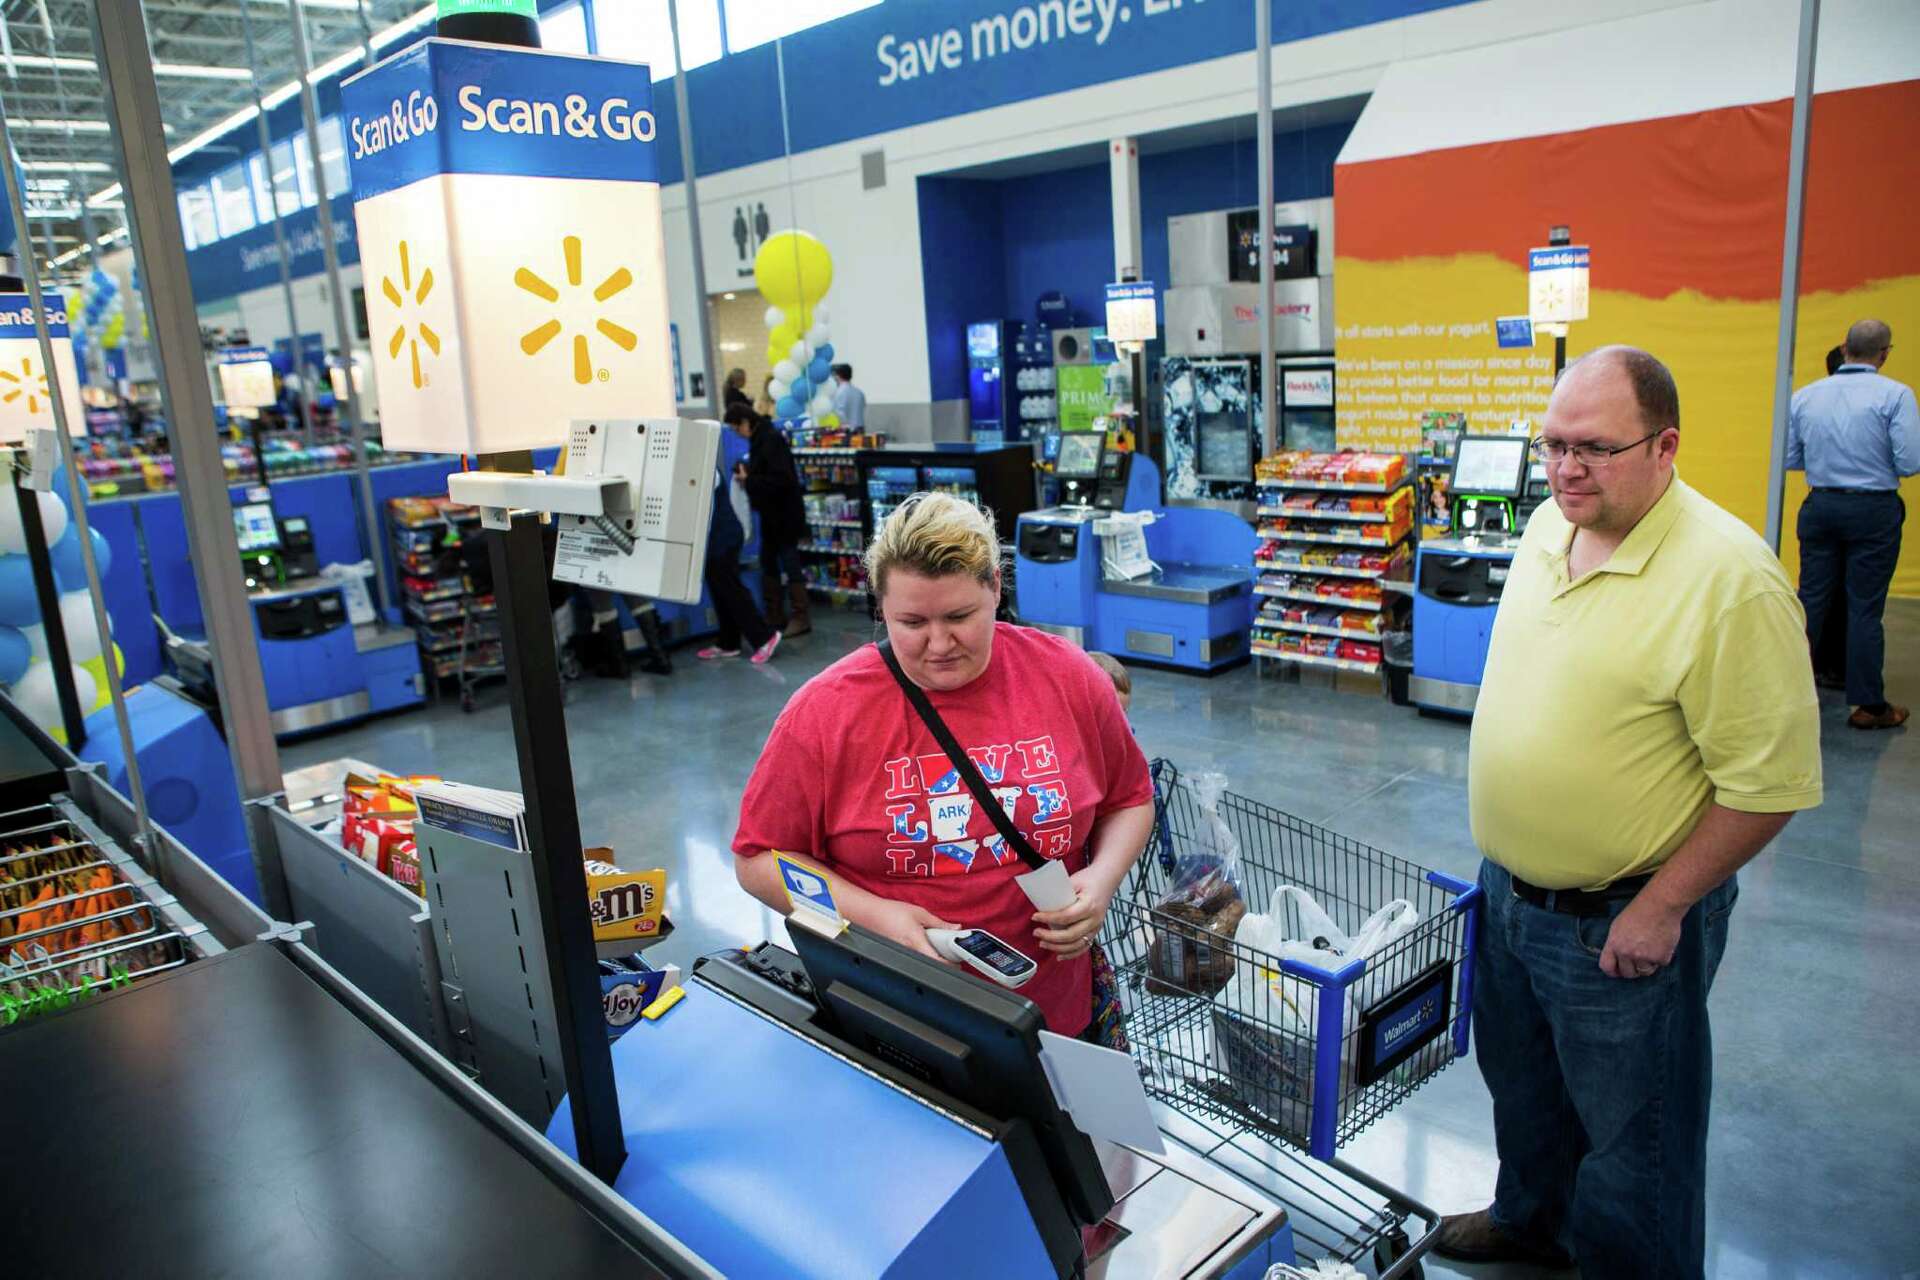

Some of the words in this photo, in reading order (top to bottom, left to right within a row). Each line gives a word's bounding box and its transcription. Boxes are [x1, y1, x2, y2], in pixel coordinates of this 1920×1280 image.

[877, 28, 963, 86] Save
[971, 0, 1131, 61] money.
[351, 90, 439, 160] Scan&Go
[458, 85, 657, 143] Scan&Go
[1396, 323, 1422, 337] with
[1525, 353, 1551, 371] day
[1061, 391, 1100, 405] PRIM
[591, 883, 654, 925] &m's
[1384, 1009, 1421, 1044] Walmart
